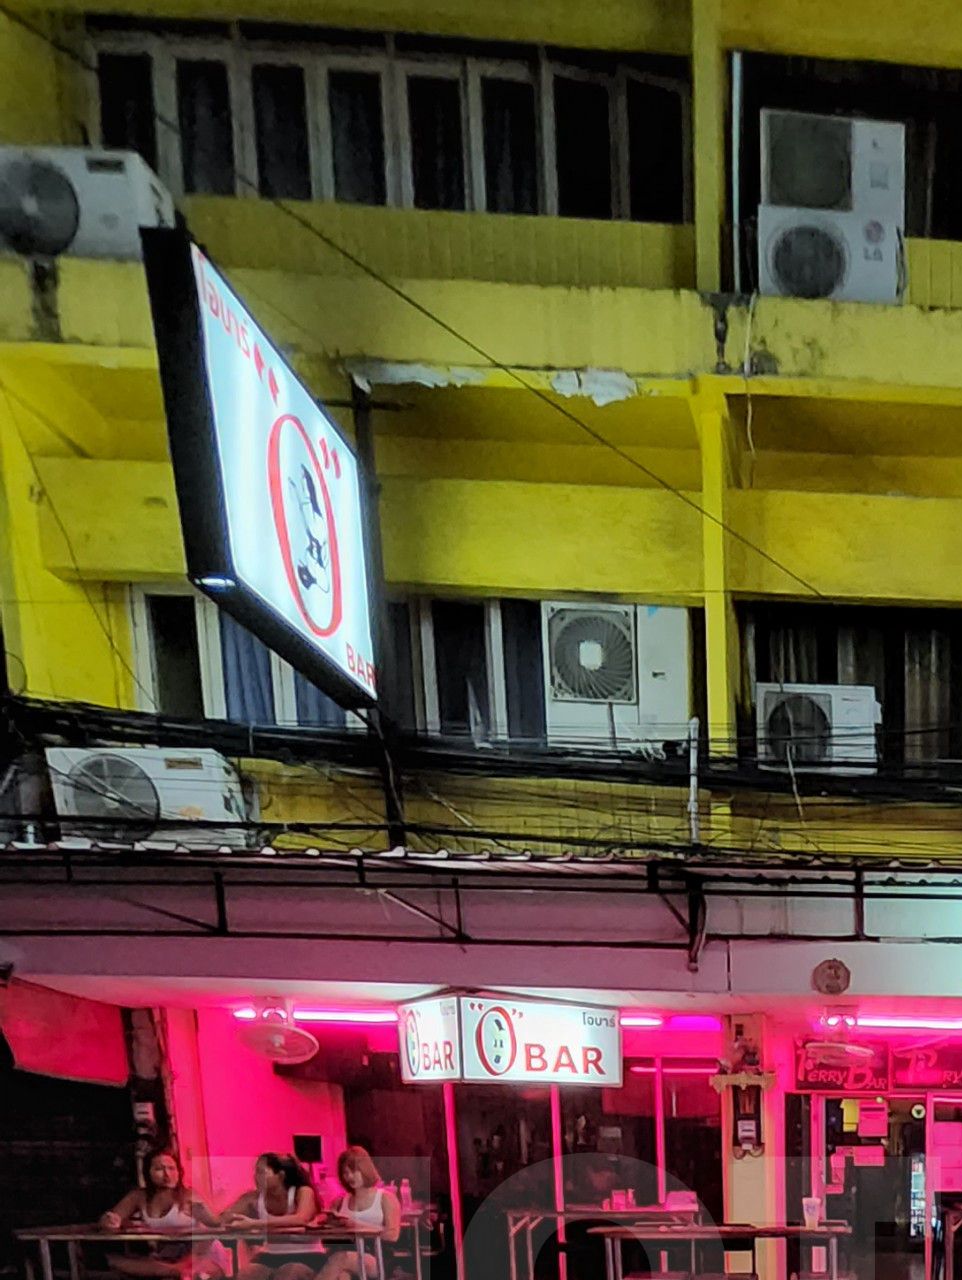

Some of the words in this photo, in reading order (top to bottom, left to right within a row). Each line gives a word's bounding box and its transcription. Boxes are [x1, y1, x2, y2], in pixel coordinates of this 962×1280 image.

[346, 641, 378, 687] BAR
[422, 1040, 455, 1071] BAR
[524, 1043, 607, 1076] BAR
